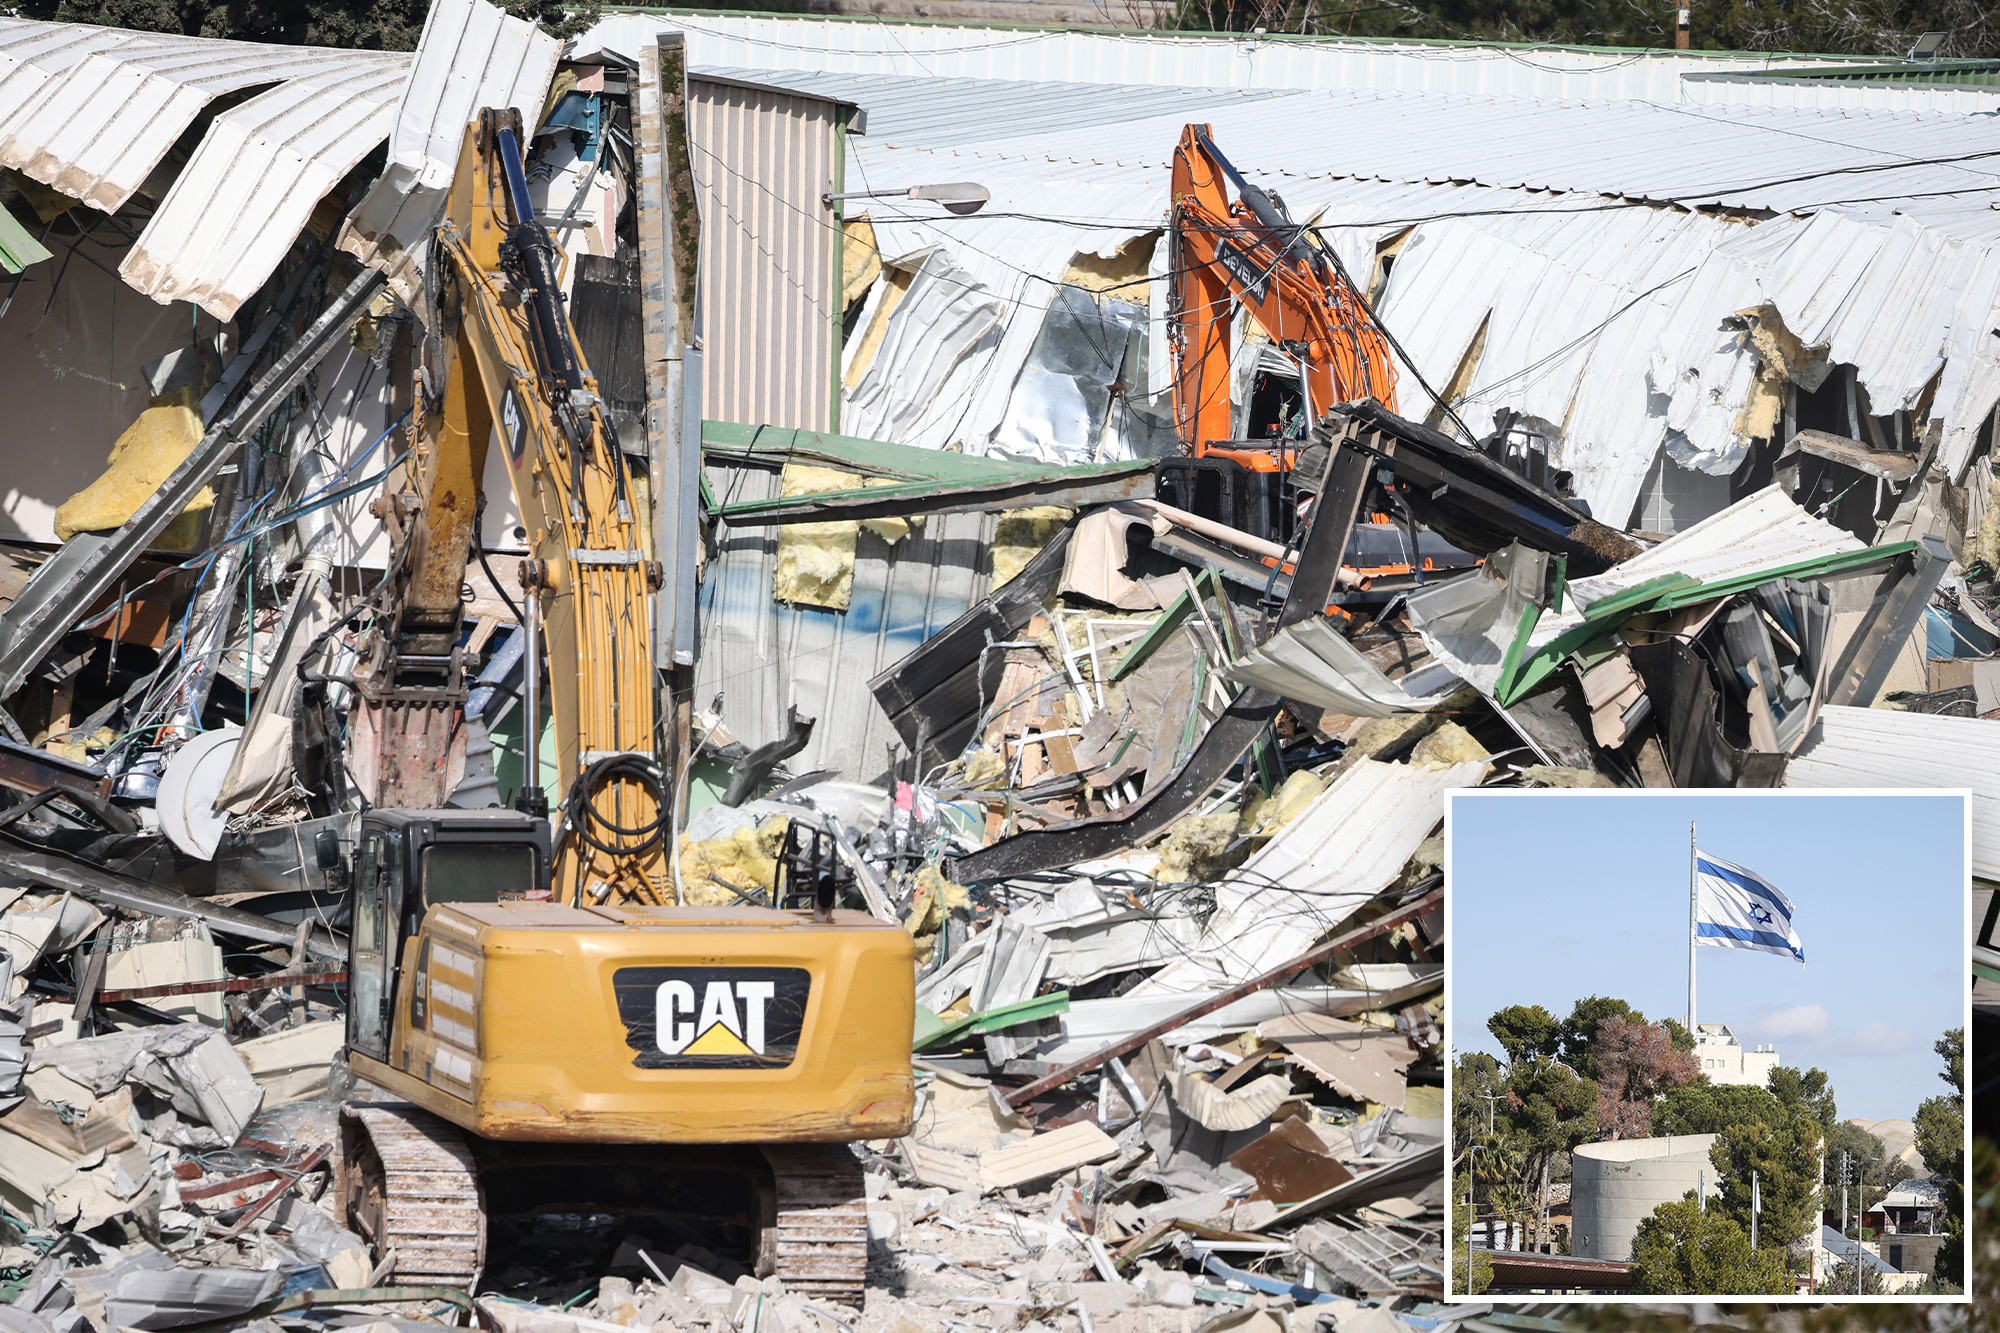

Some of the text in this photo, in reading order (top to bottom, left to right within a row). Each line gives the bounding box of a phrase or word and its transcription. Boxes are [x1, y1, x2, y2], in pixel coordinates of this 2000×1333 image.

[503, 389, 521, 453] CAT
[416, 970, 427, 999] CAT
[655, 979, 775, 1055] CAT
